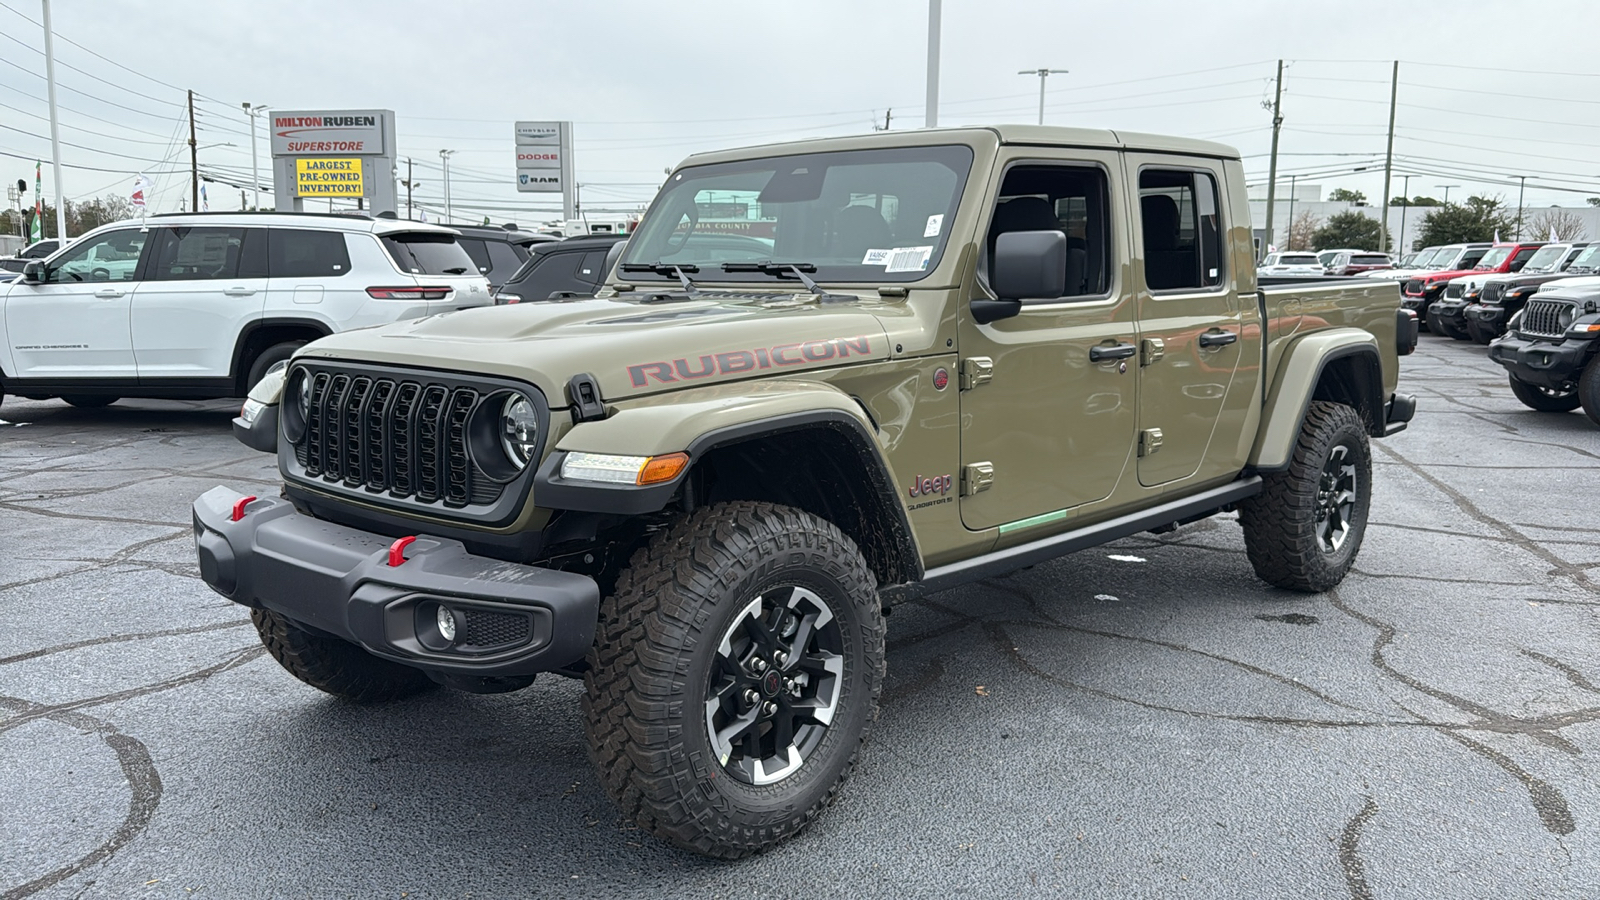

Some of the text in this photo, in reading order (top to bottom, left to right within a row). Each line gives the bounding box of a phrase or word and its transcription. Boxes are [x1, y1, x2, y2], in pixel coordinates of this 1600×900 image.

[287, 141, 364, 152] SUPERSTORE
[306, 161, 352, 170] LARGEST
[300, 173, 360, 182] PRE-OWNED
[300, 184, 361, 193] INVENTORY!
[626, 335, 871, 388] RUBICON
[909, 474, 952, 497] Jeep
[907, 498, 946, 511] GLADIATOR
[733, 552, 868, 609] WILDPEAK
